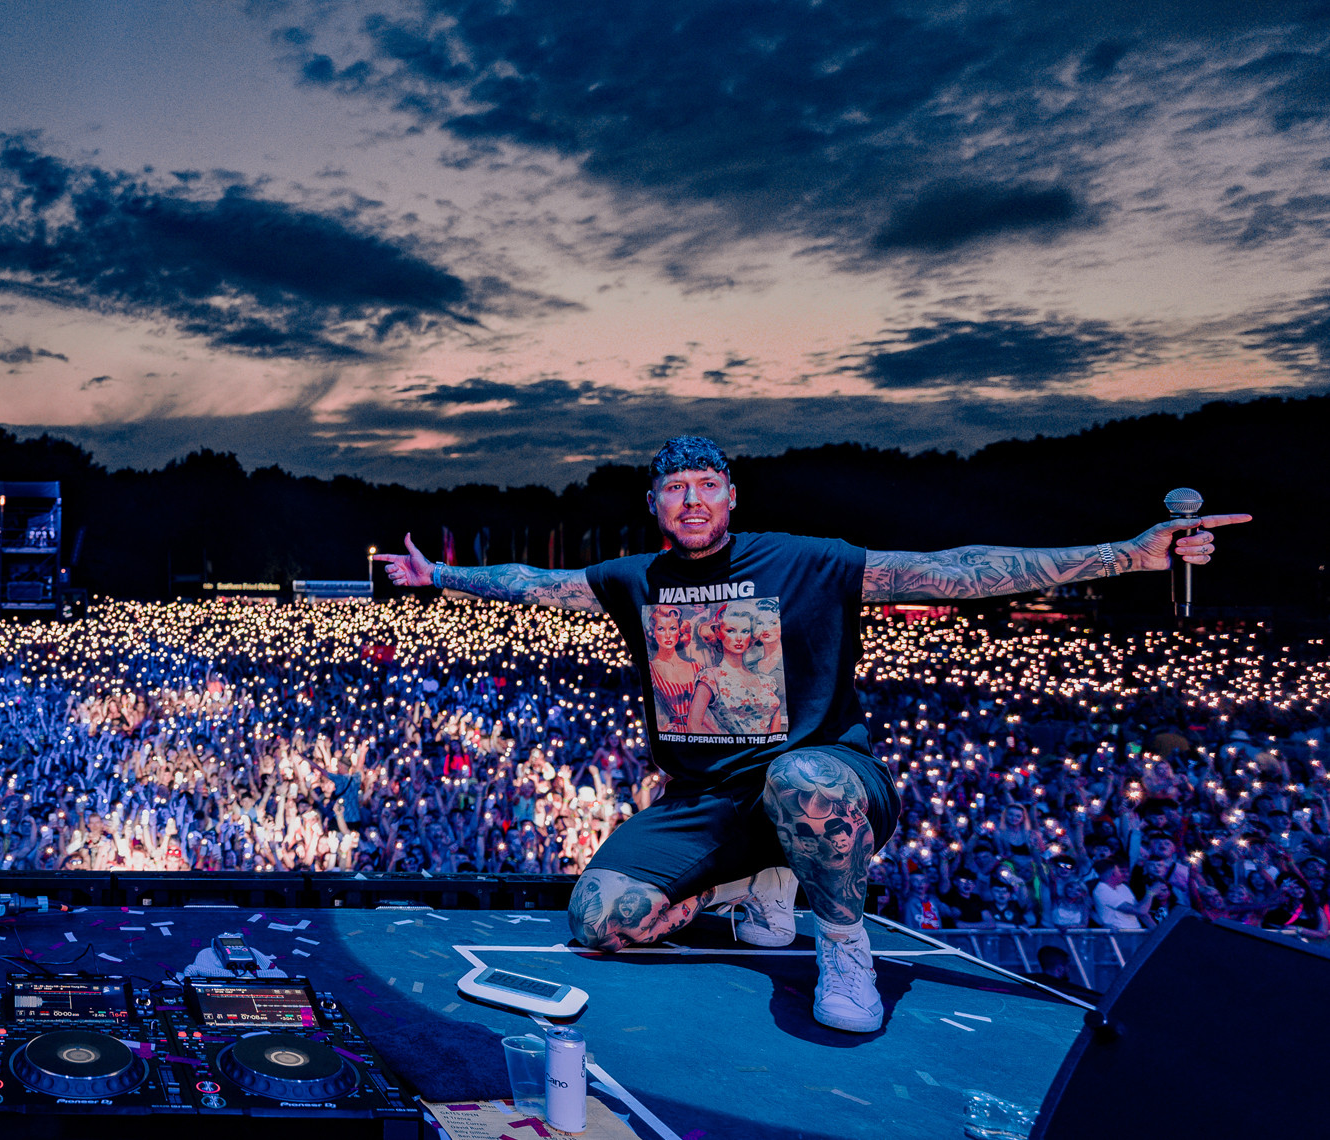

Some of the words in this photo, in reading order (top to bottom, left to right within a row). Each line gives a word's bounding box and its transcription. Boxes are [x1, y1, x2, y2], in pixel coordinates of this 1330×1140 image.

[242, 582, 257, 590] Fried
[258, 582, 280, 590] Chicken
[658, 581, 755, 603] WARNING
[658, 733, 686, 743] HATERS
[687, 734, 735, 744] OPERATING
[736, 736, 746, 744] IN
[747, 736, 766, 744] THE
[767, 733, 788, 744] AREA
[546, 1072, 568, 1089] Cano
